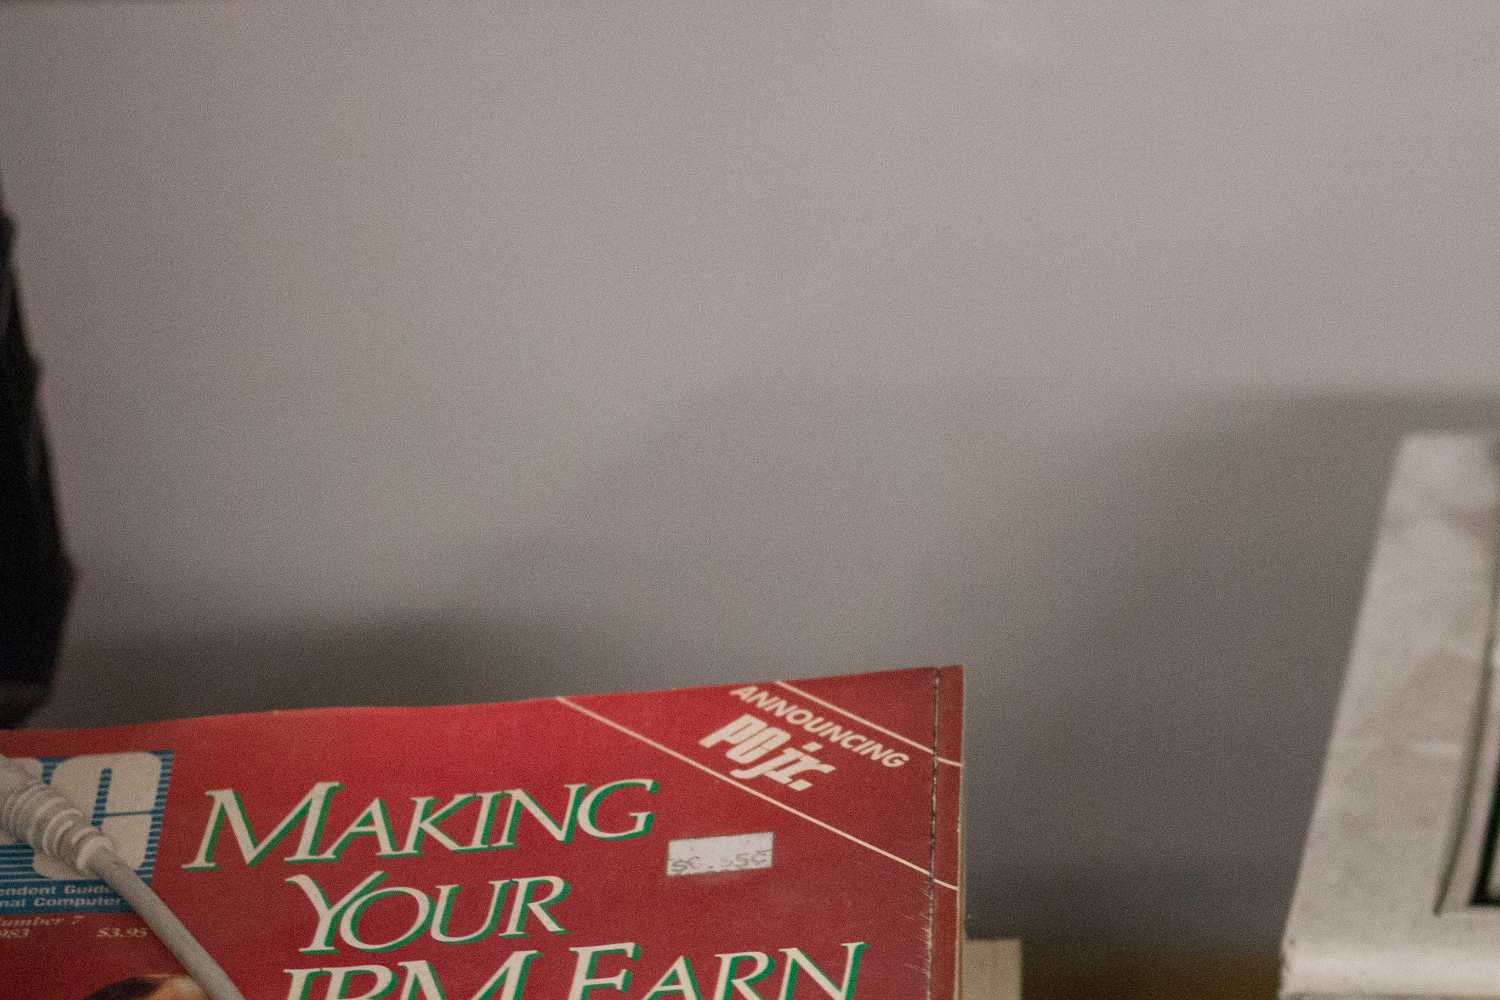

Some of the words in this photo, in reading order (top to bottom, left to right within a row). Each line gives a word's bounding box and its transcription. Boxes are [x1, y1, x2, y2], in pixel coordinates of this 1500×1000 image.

[729, 685, 910, 767] ANNOUNCING
[181, 779, 660, 872] MAKING
[286, 871, 571, 955] YOUR
